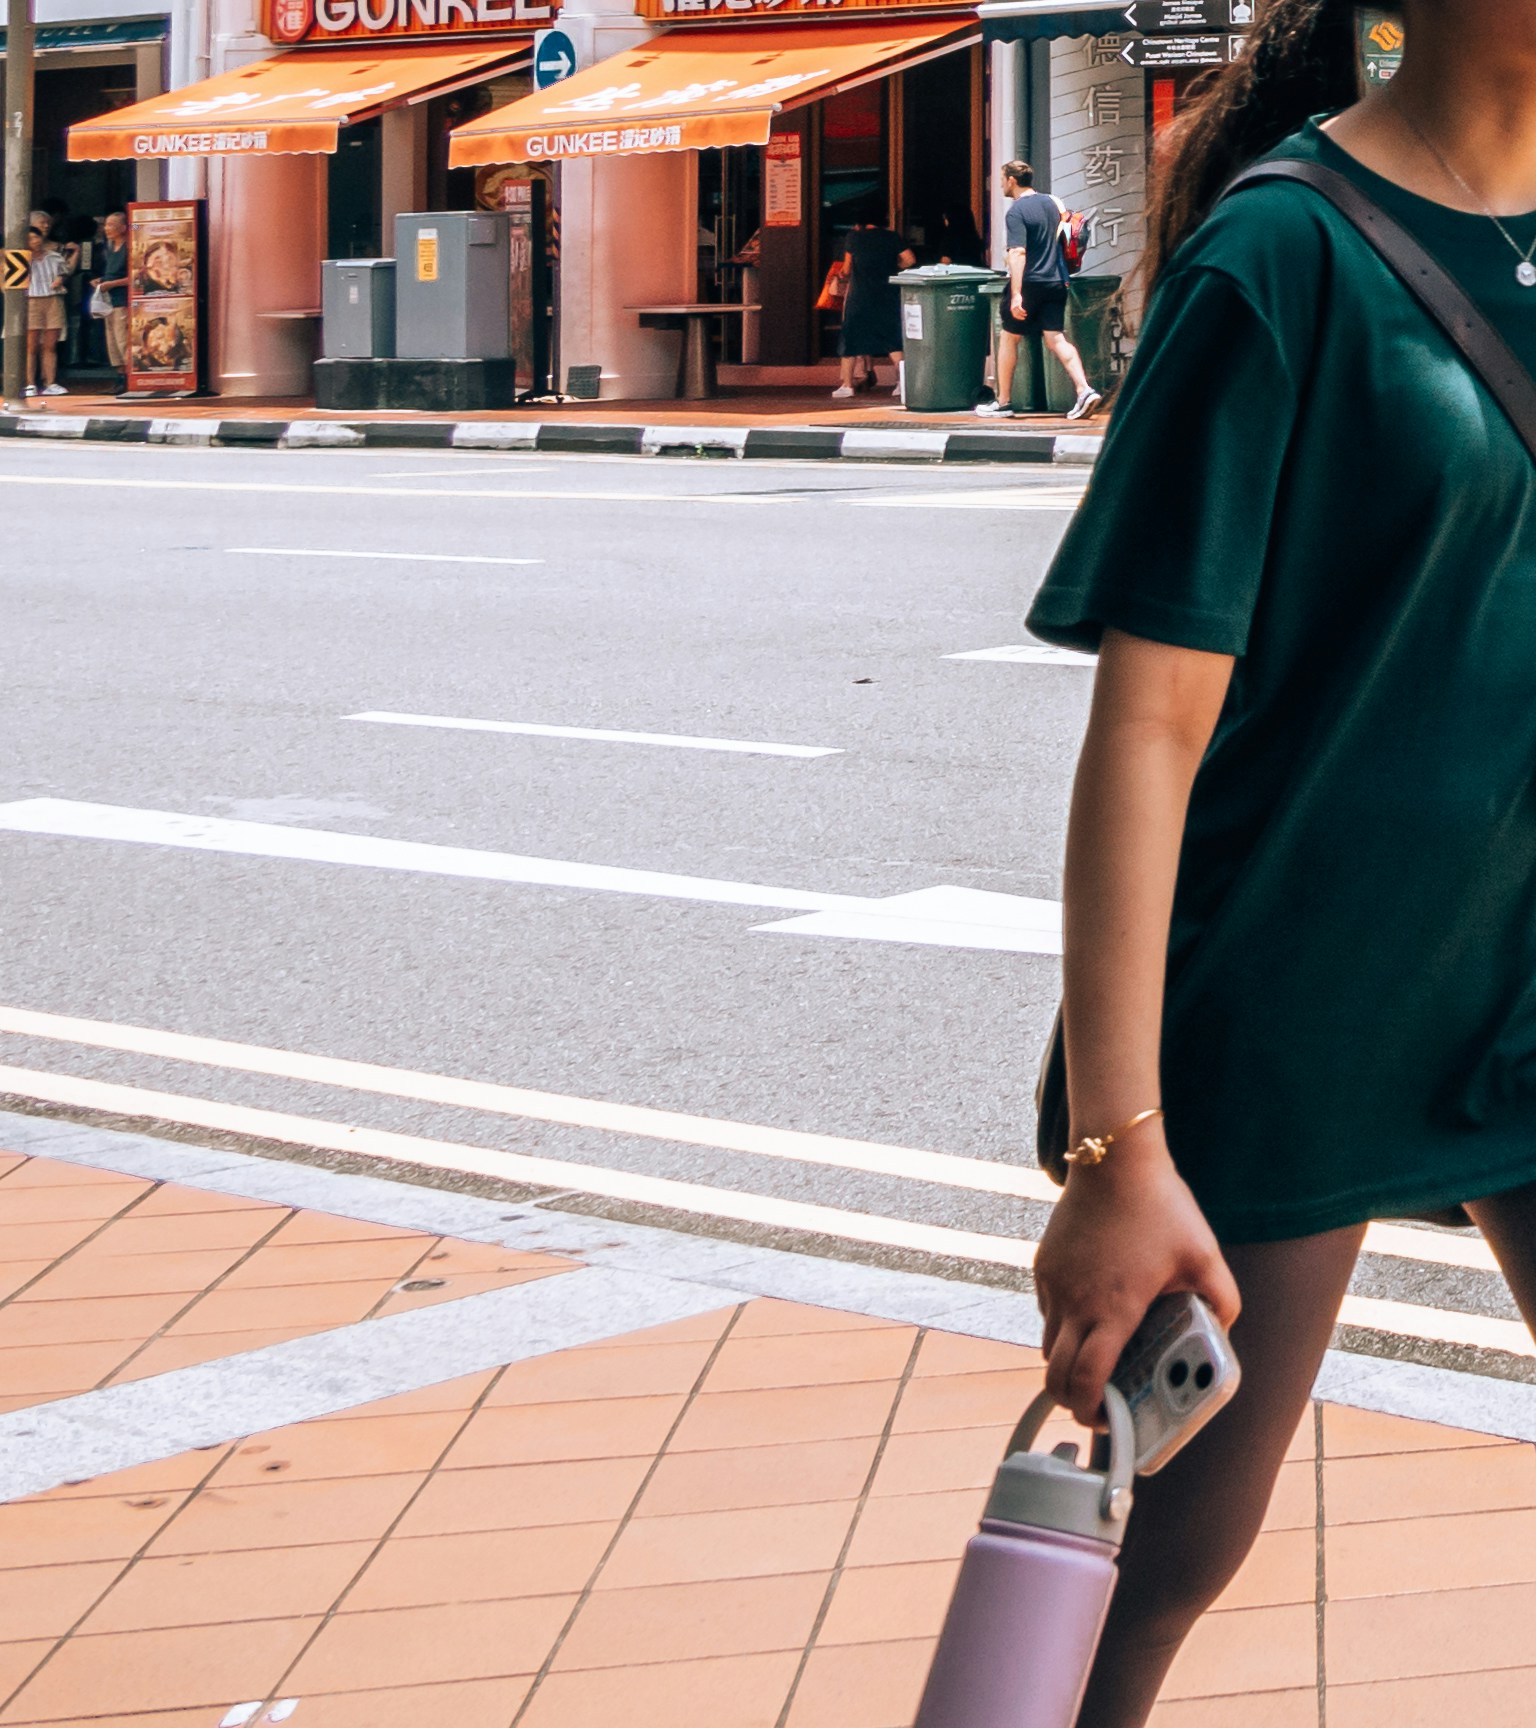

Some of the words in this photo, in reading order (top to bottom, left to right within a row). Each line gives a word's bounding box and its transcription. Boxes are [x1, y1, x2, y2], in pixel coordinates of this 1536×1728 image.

[134, 133, 212, 155] GUNKEE
[525, 129, 618, 157] GUNKEE
[619, 125, 681, 151] 灌记砂锅
